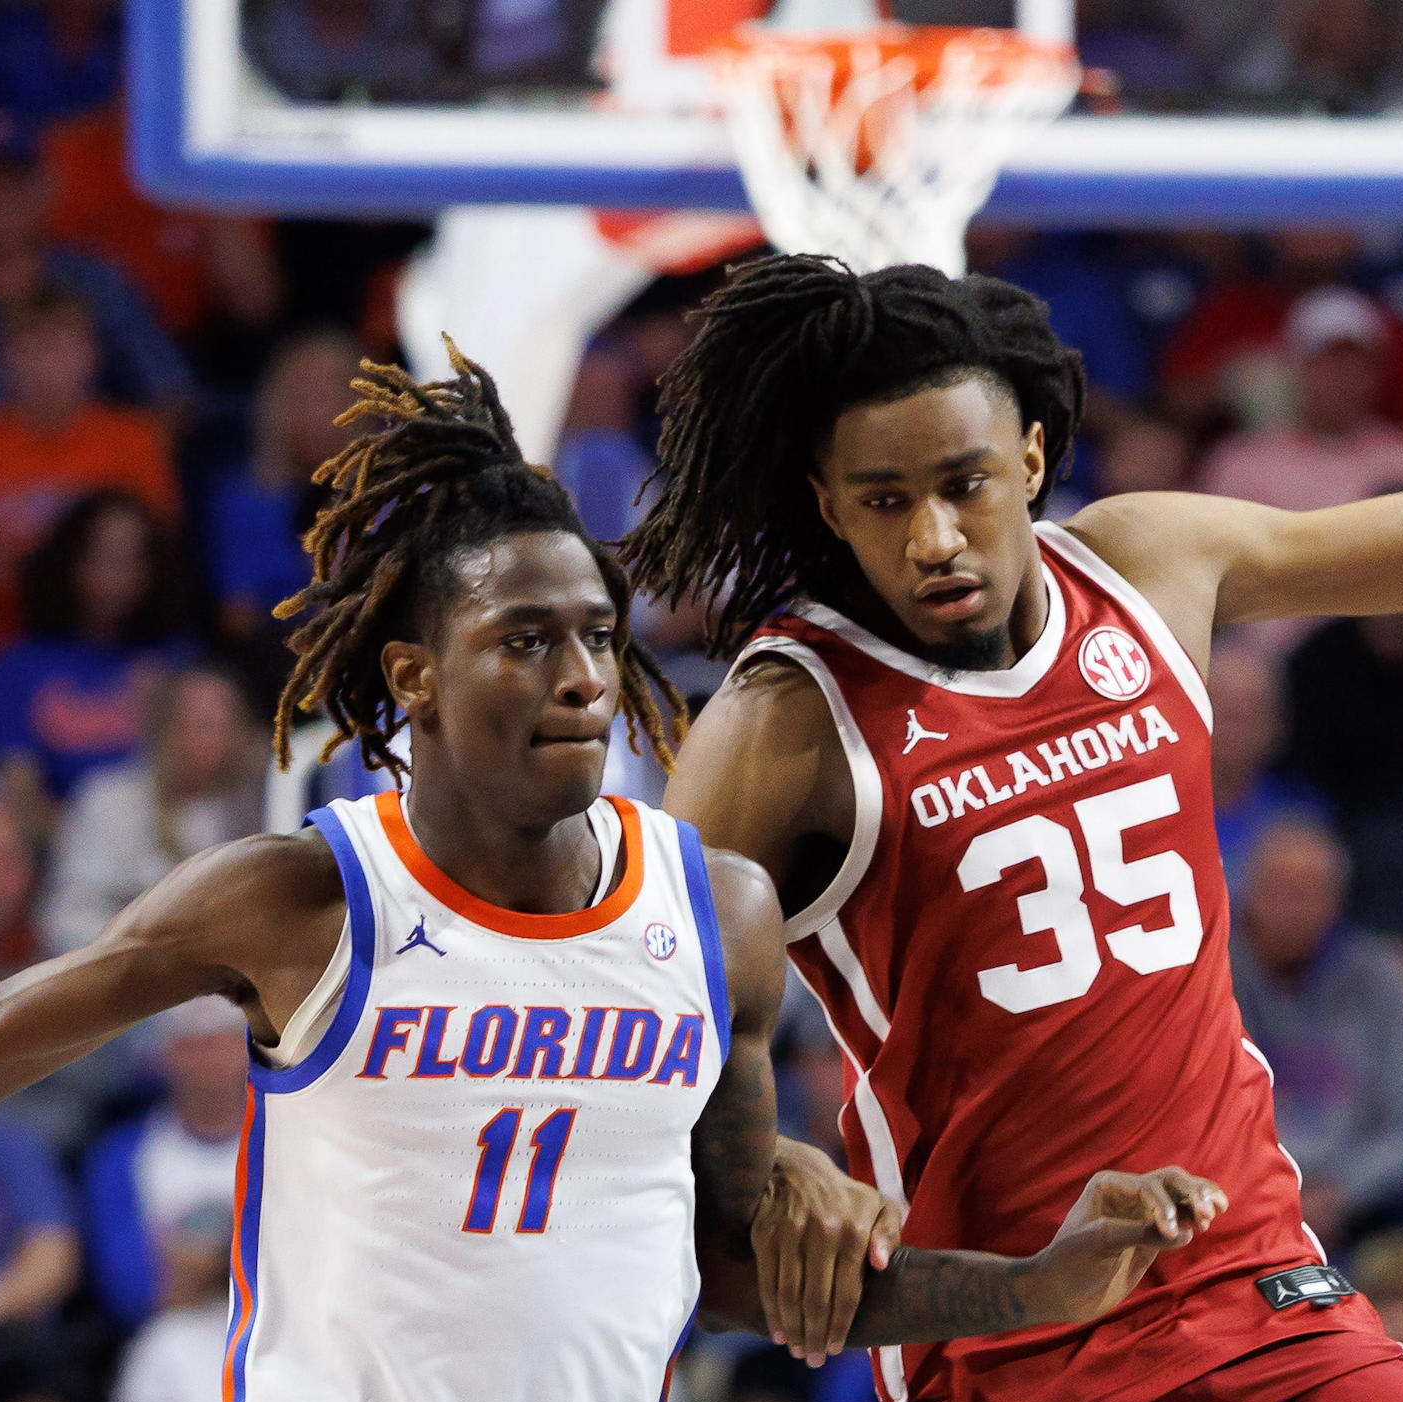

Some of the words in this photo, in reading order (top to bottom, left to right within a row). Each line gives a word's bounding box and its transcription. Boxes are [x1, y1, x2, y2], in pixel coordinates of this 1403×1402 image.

[1084, 630, 1146, 696] SEC
[911, 705, 1179, 828] OKLAHOMA
[646, 923, 676, 959] SEC
[956, 773, 1203, 1014] 35
[355, 1006, 704, 1087] FLORIDA
[462, 1108, 577, 1234] 11
